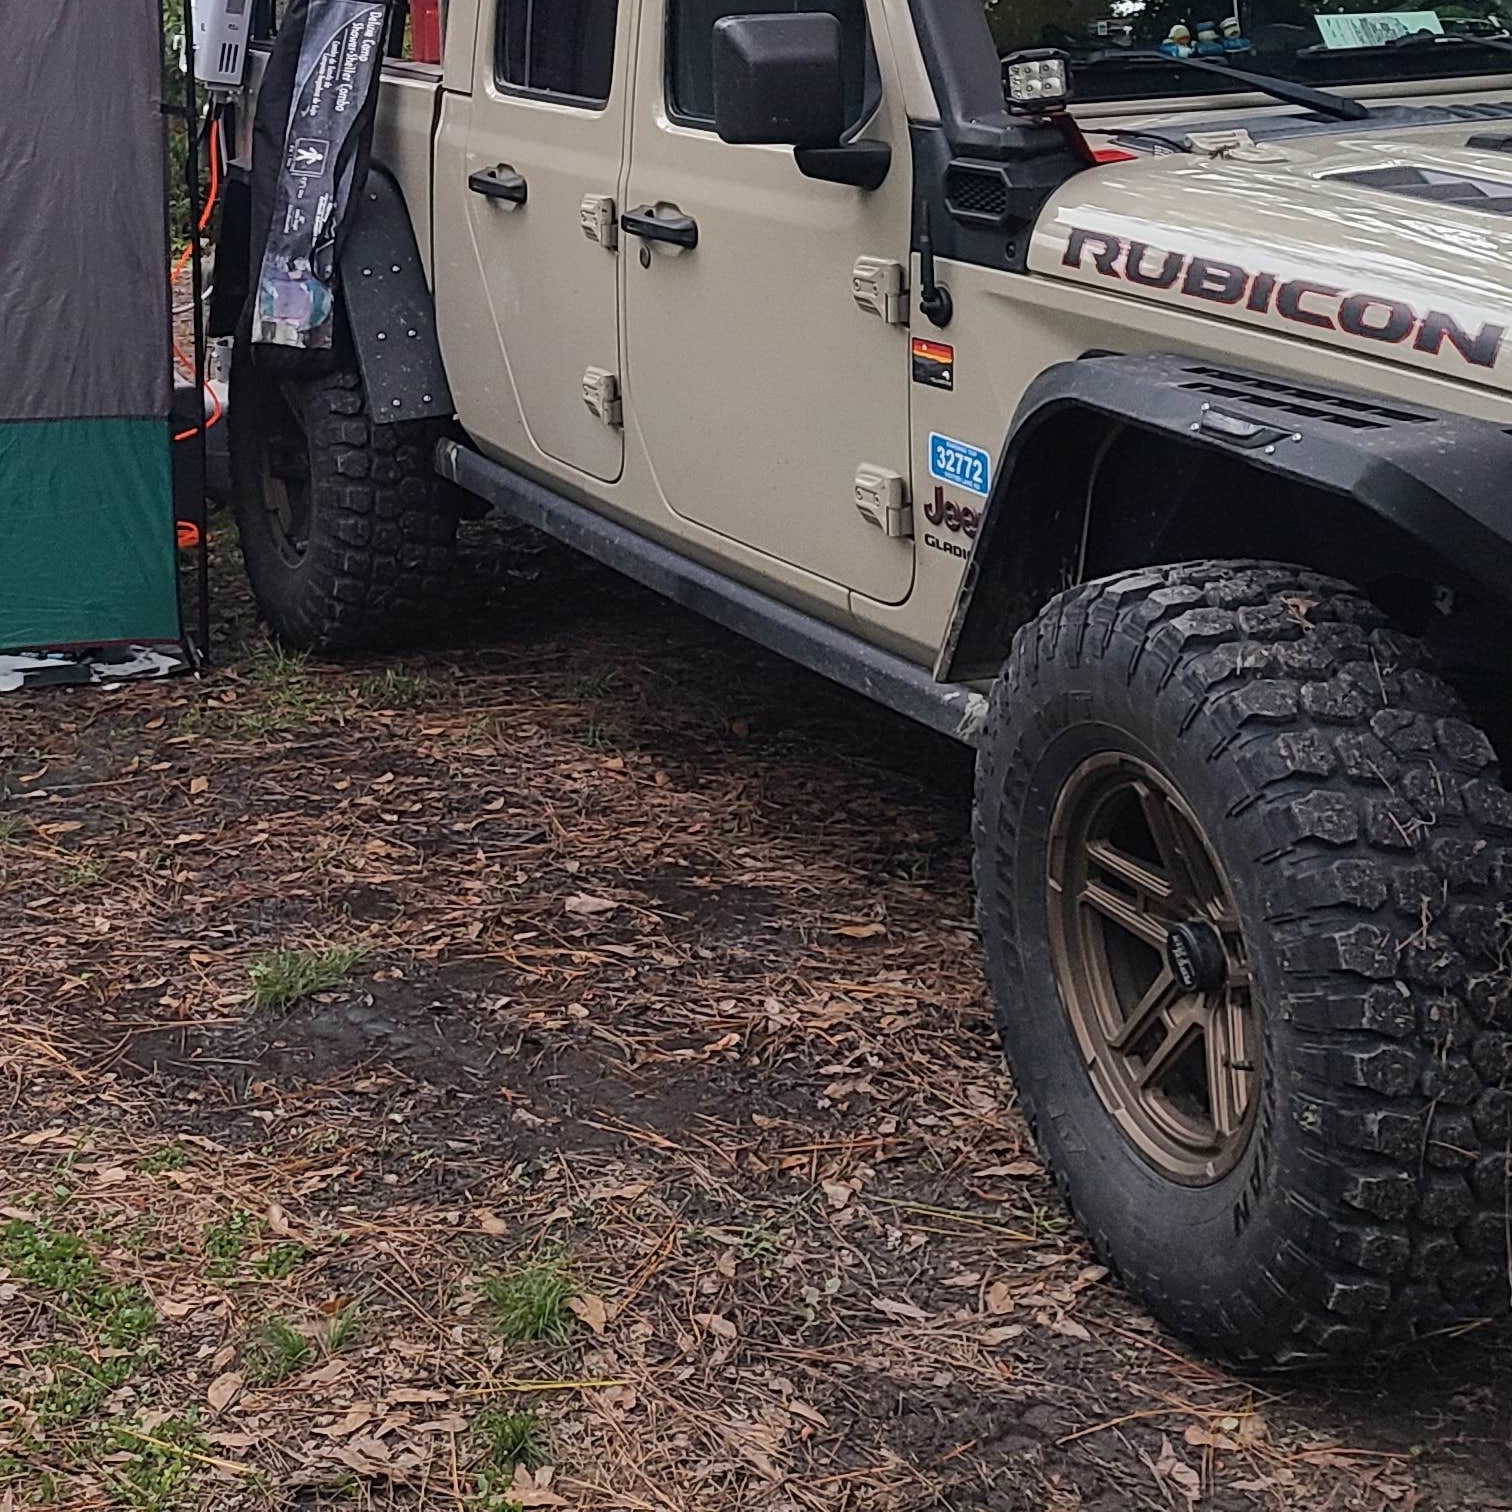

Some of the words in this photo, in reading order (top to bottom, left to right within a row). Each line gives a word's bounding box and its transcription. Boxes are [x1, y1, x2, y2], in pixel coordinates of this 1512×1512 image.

[364, 11, 383, 37] Deluxe
[335, 83, 353, 112] Combo
[1061, 226, 1506, 369] RUBICON
[936, 445, 983, 484] 32772
[924, 486, 982, 539] Jee
[924, 533, 968, 560] GLADI
